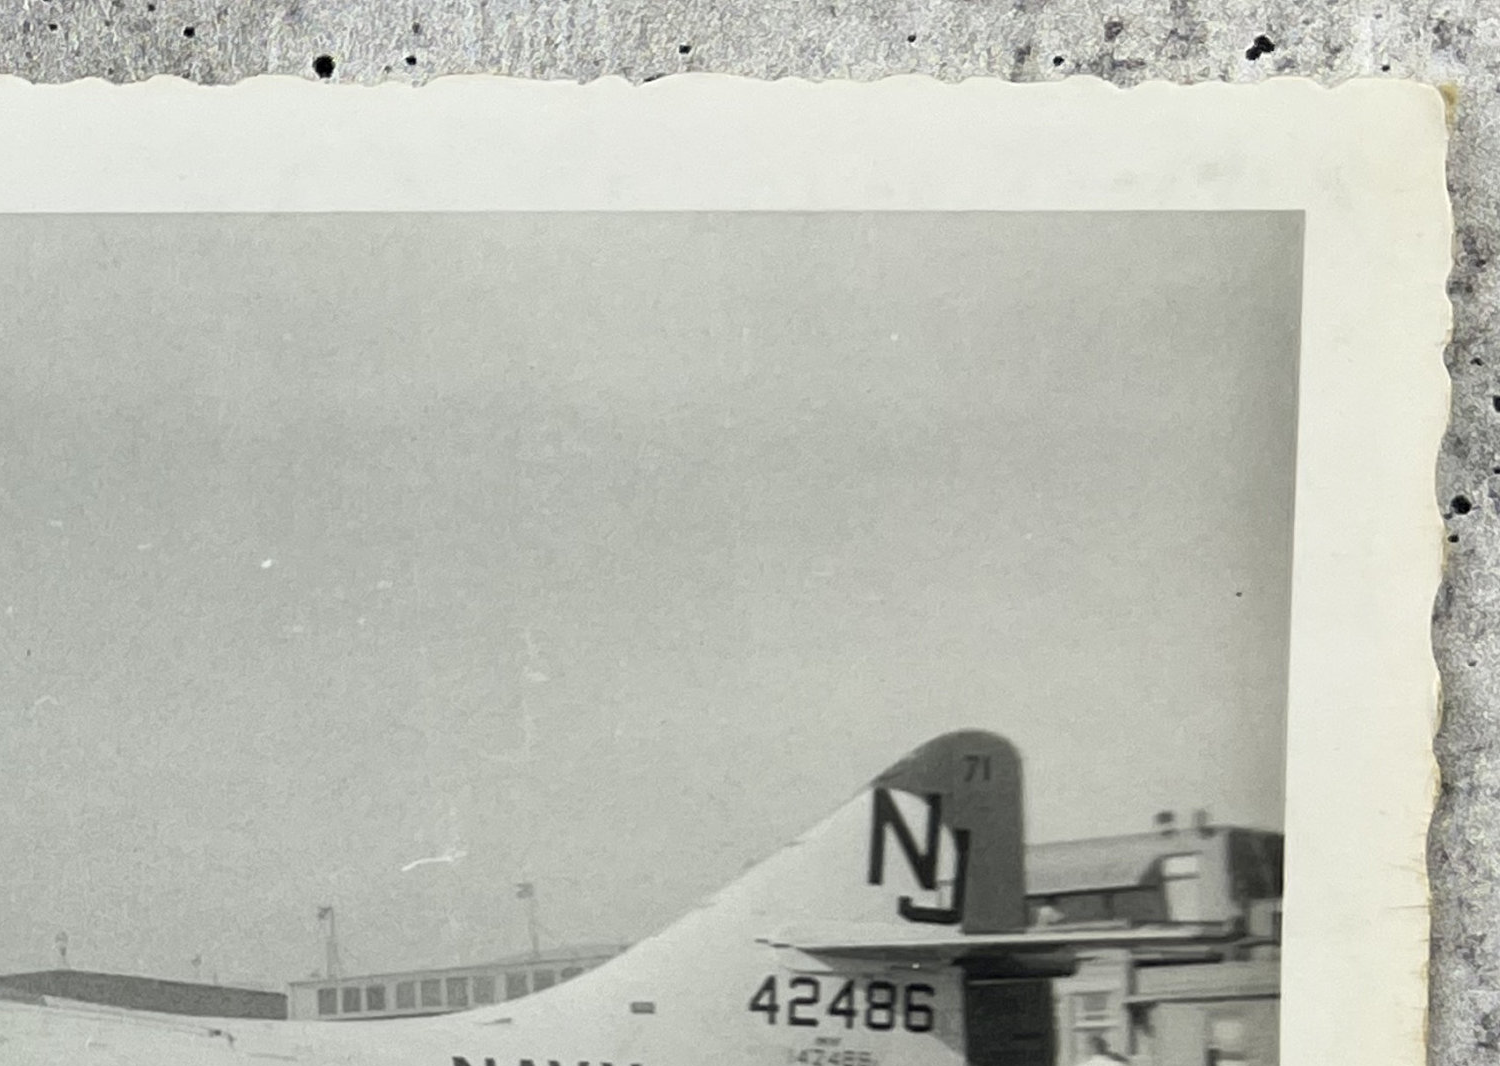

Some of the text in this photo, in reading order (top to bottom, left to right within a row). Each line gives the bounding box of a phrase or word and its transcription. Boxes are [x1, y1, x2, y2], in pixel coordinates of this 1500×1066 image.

[964, 754, 991, 782] 71
[868, 786, 971, 926] NJ
[749, 975, 935, 1033] 42486
